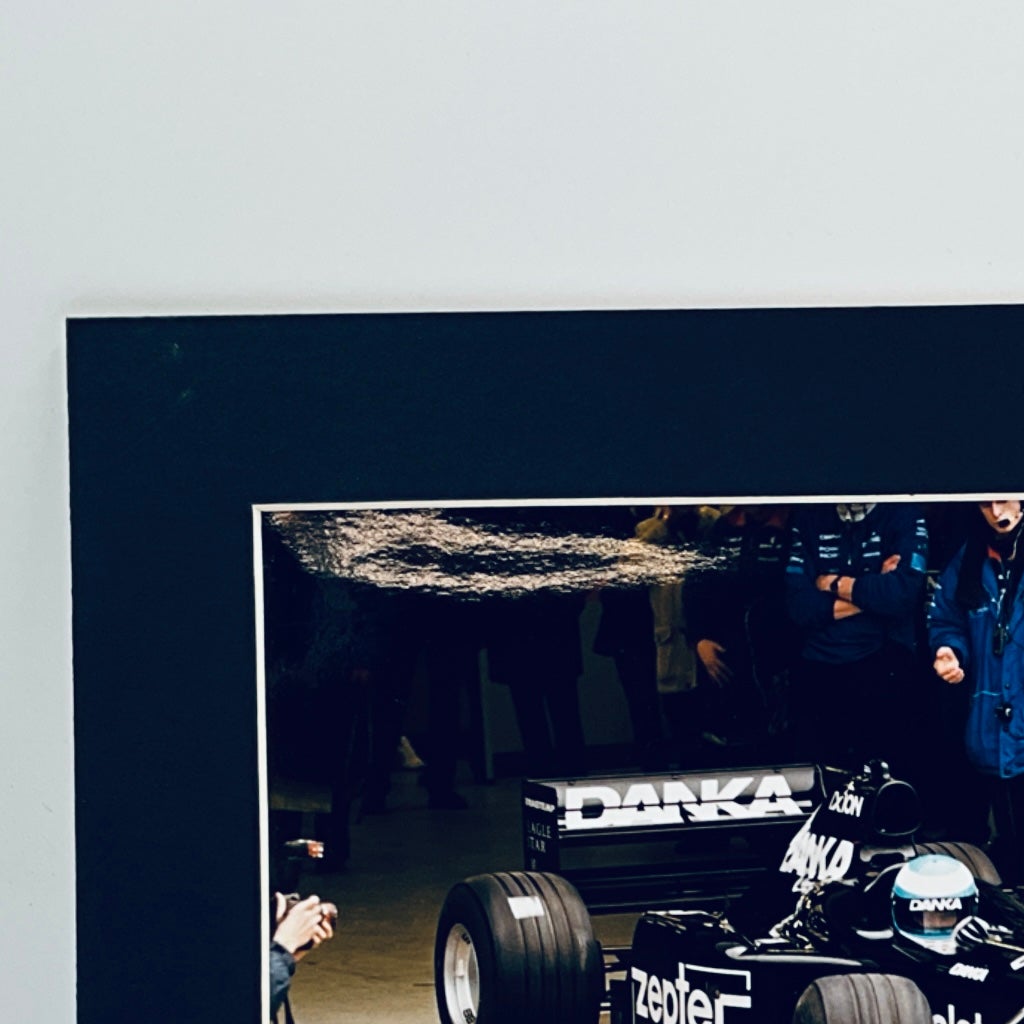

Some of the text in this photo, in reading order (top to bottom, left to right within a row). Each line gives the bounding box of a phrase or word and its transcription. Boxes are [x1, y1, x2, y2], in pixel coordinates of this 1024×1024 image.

[565, 774, 804, 829] DANKA
[527, 822, 552, 839] AGLE
[527, 836, 546, 854] TAR
[909, 897, 963, 912] DANKA
